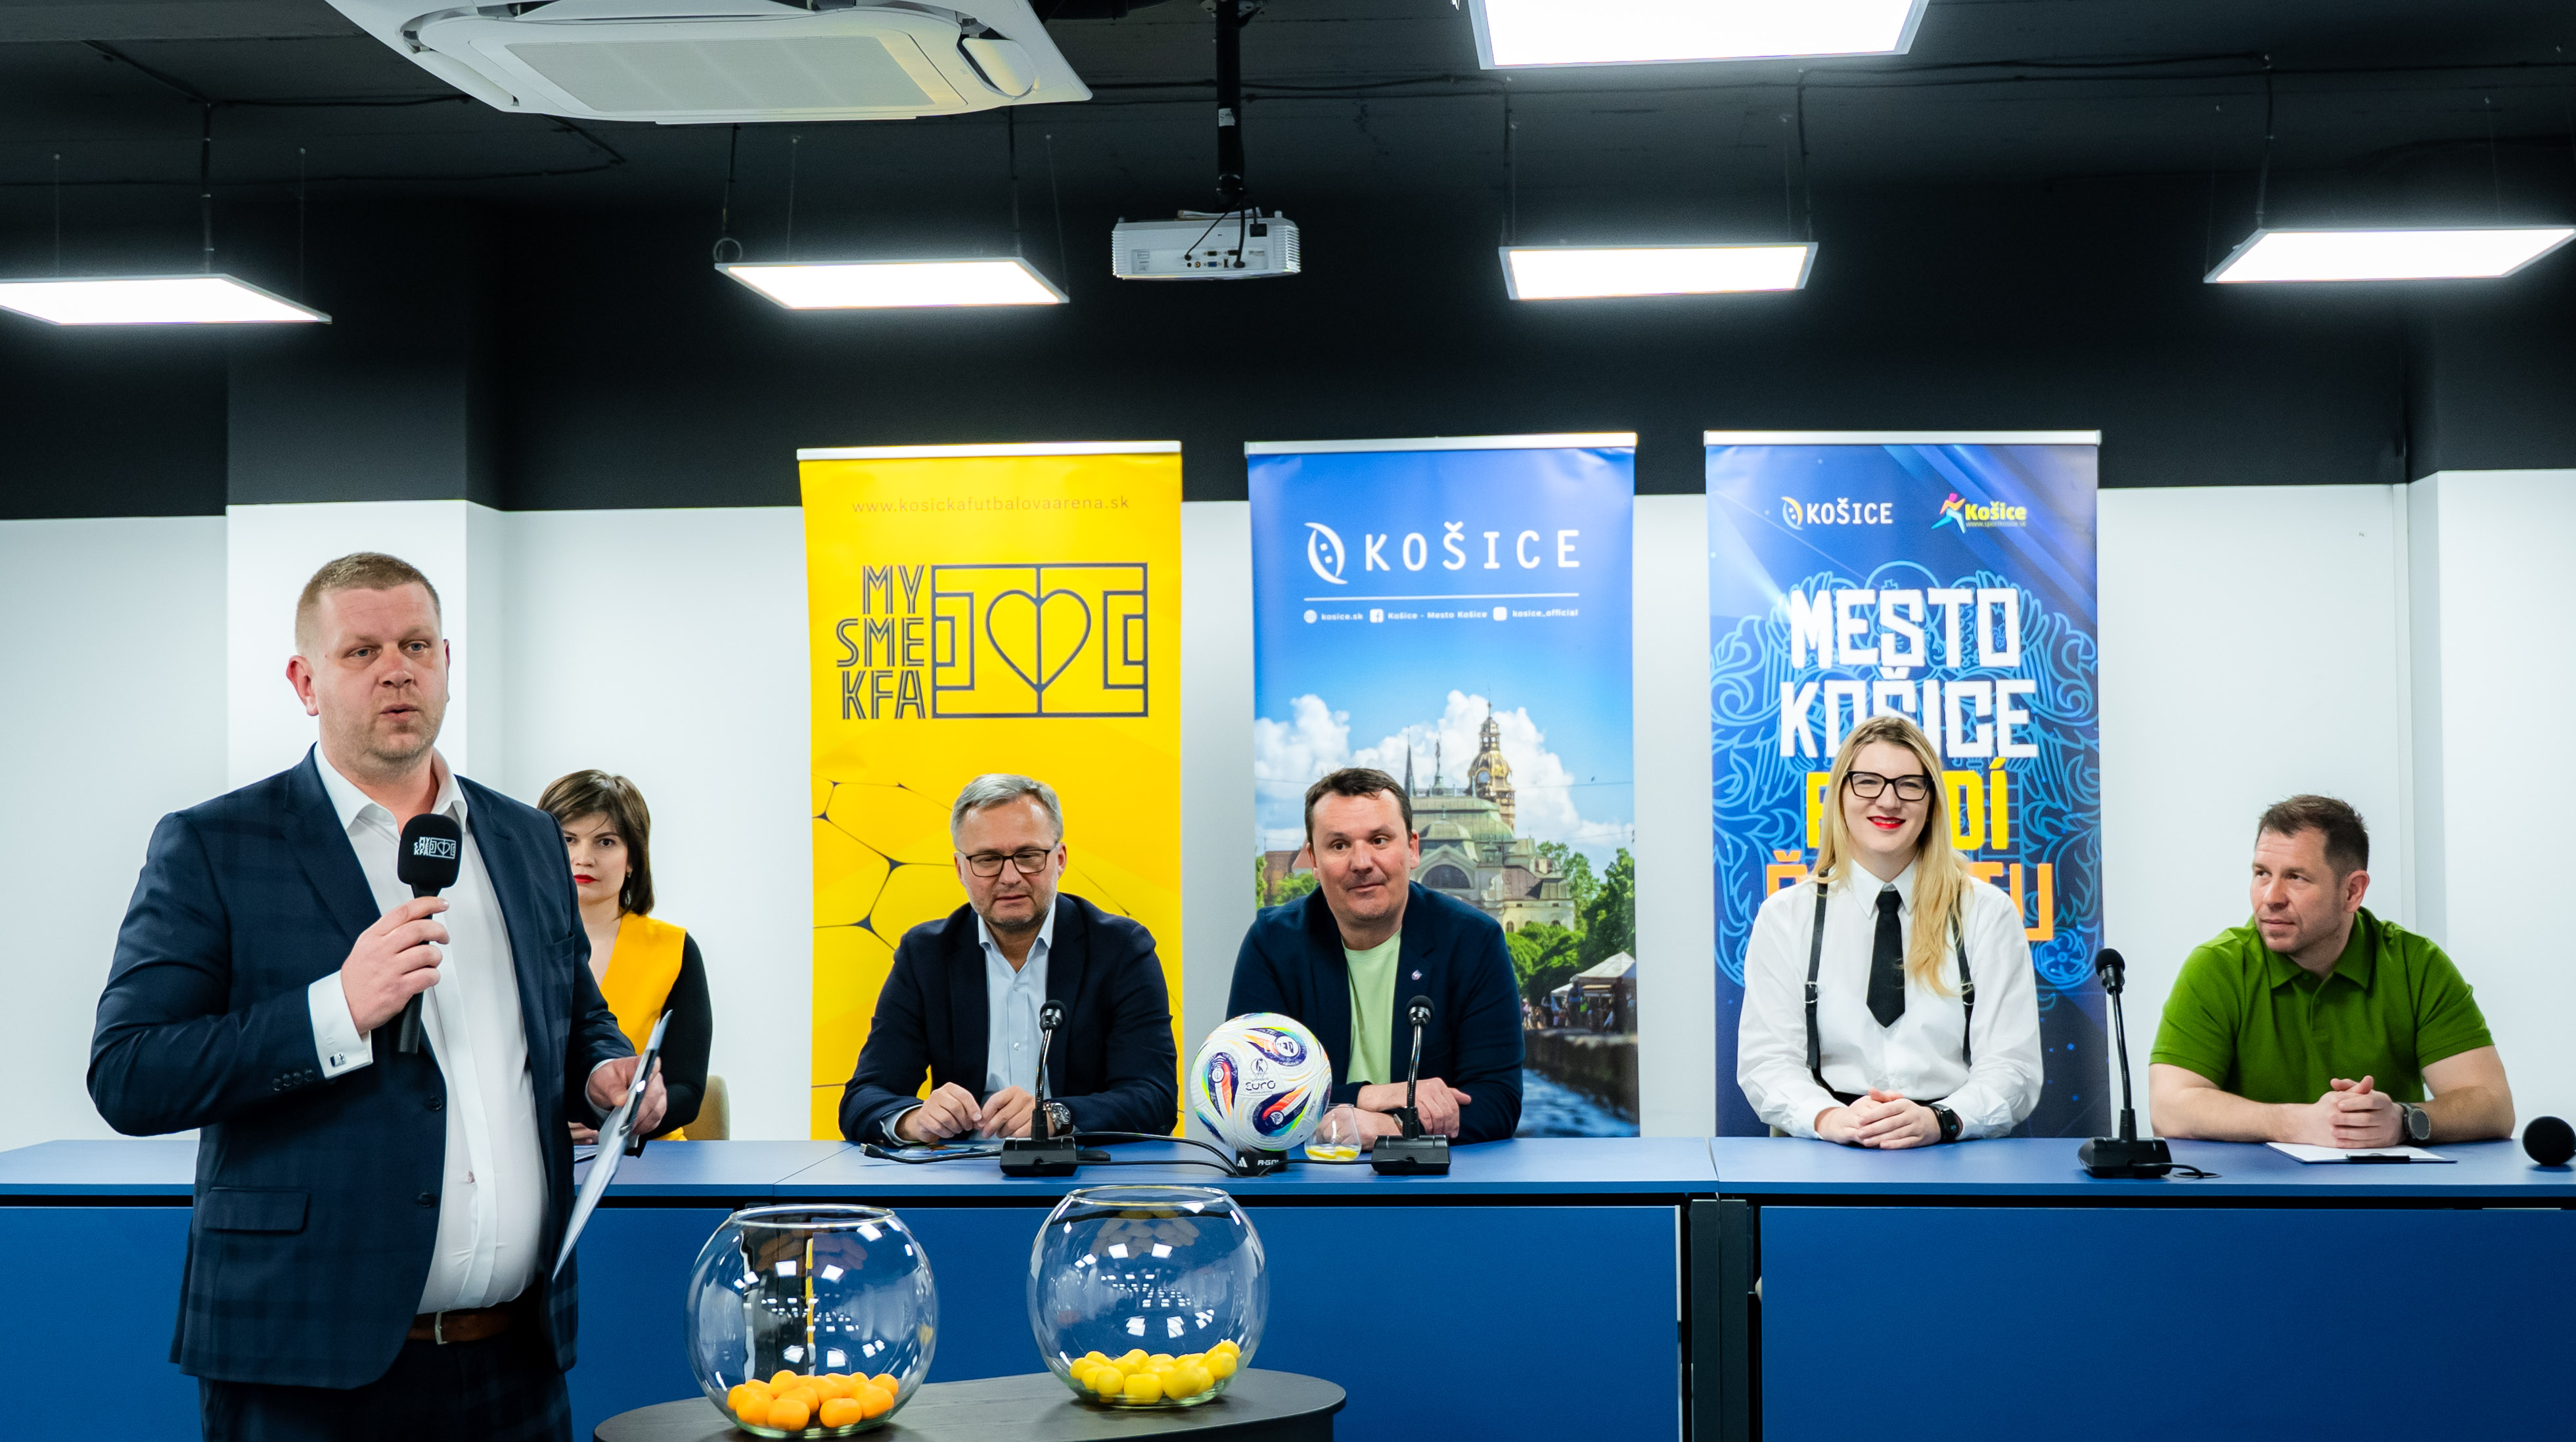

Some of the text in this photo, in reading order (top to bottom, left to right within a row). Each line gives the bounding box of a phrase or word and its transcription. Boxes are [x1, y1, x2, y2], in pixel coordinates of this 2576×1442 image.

[852, 495, 1129, 513] www.kosickafutbalovaarena.sk
[1807, 497, 1893, 525] KOŠICE
[1965, 502, 2027, 521] Košice
[1365, 521, 1580, 572] KOŠICE
[863, 564, 925, 615] MY
[1321, 612, 1363, 621] kosice.sk
[1388, 611, 1418, 620] Košice
[1457, 610, 1488, 619] Košice
[1512, 608, 1579, 618] kosice_official
[836, 617, 925, 667] SME
[1790, 587, 2021, 669] MESTO
[842, 669, 926, 720] KFA
